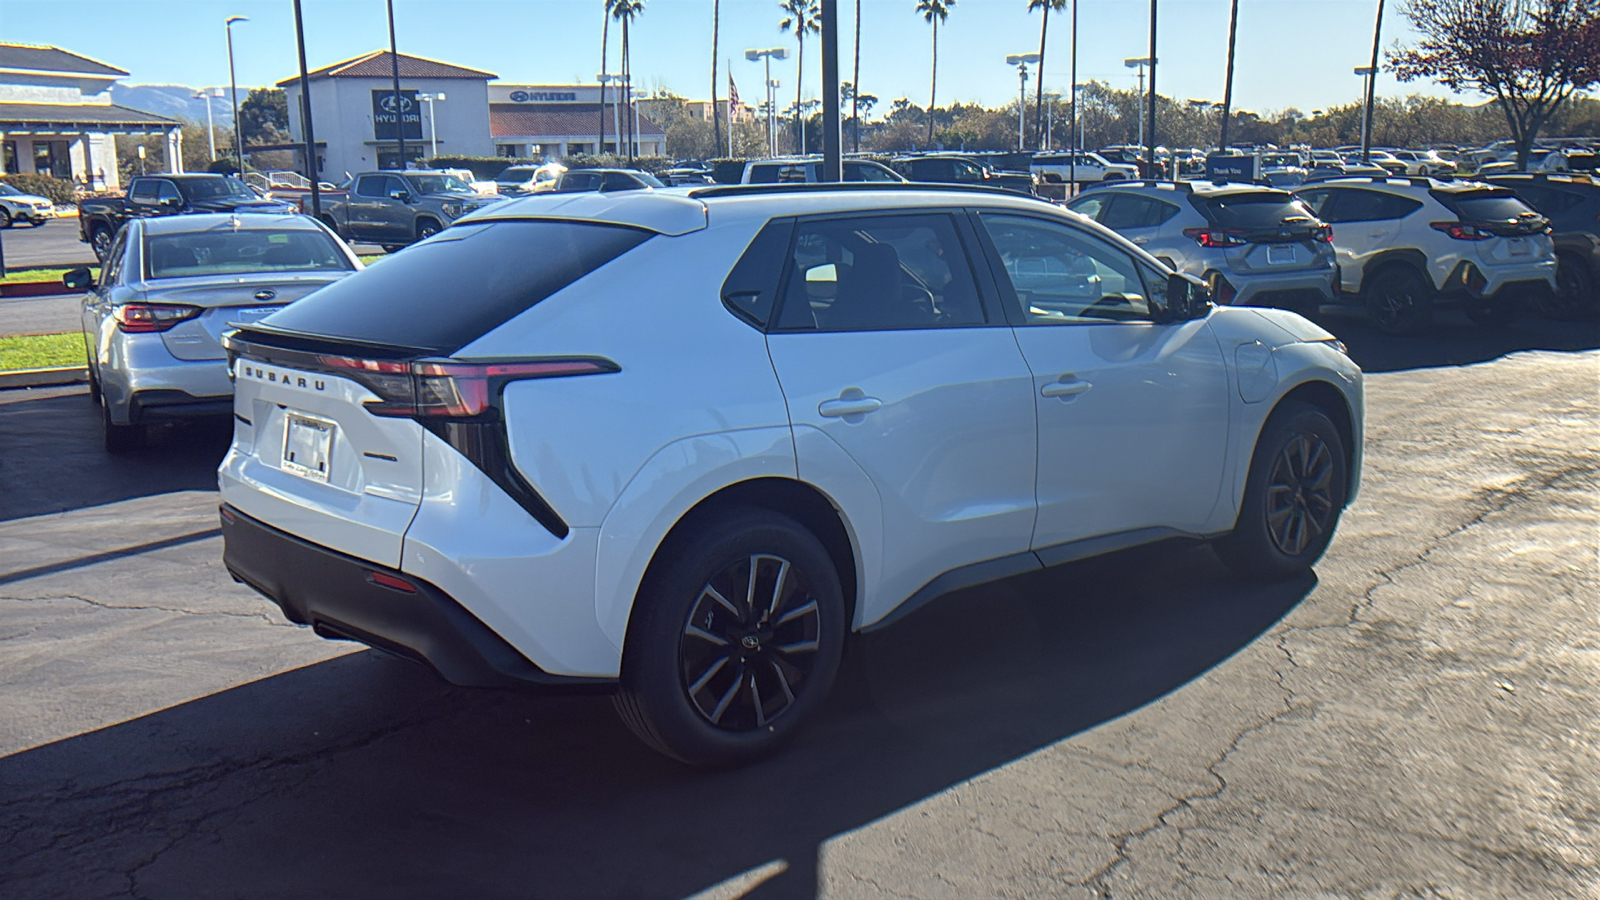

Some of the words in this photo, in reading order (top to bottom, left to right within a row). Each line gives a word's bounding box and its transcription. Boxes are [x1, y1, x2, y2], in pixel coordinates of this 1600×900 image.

[529, 92, 576, 101] HYUNDAI
[375, 114, 420, 123] HYUDAI
[1213, 167, 1230, 175] Thank
[1230, 167, 1242, 175] You
[245, 366, 325, 391] SUBARU
